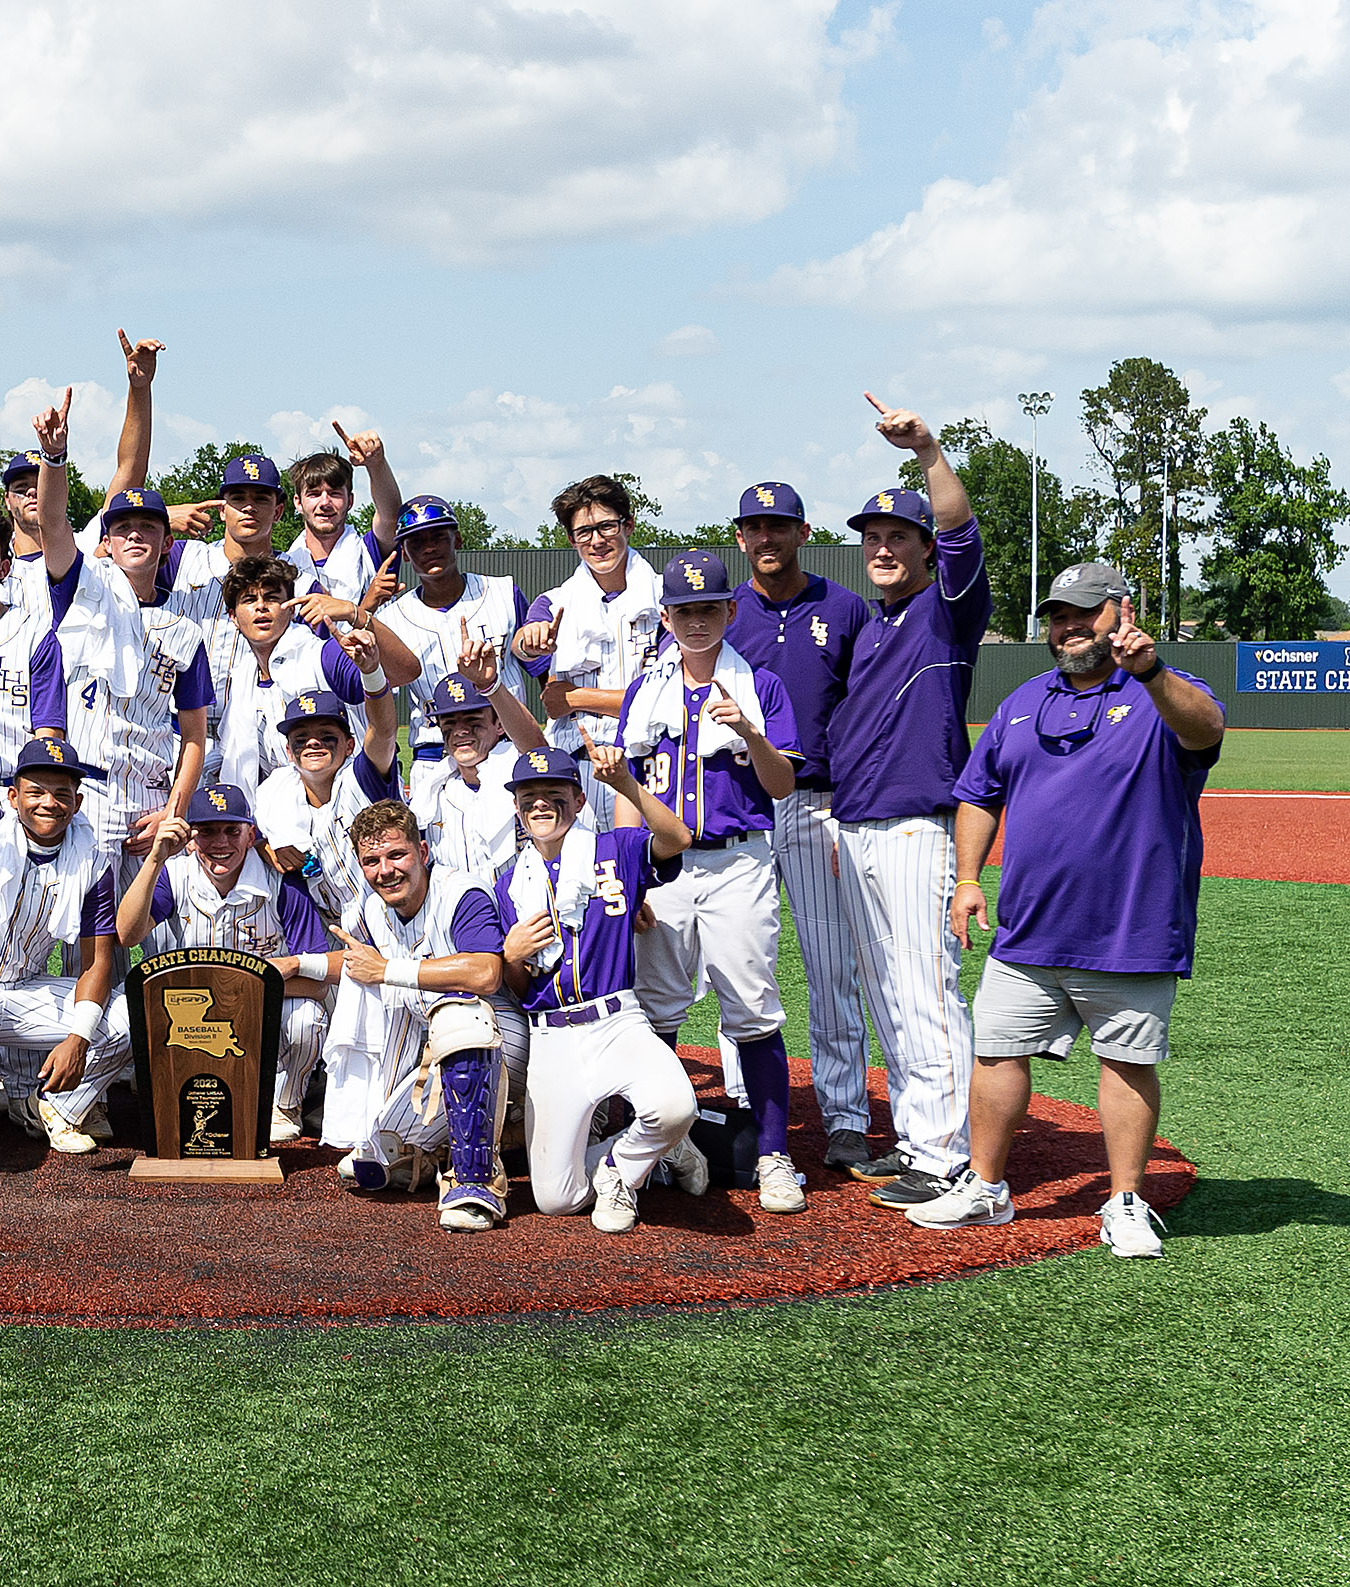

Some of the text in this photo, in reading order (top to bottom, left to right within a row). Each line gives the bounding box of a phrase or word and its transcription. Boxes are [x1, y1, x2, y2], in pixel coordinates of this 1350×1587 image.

[1262, 649, 1319, 663] Ochsner
[1255, 670, 1317, 690] STATE
[79, 677, 100, 712] 4
[641, 752, 671, 794] 39
[140, 949, 268, 975] STATE CHAMPION
[193, 1079, 218, 1088] 2023
